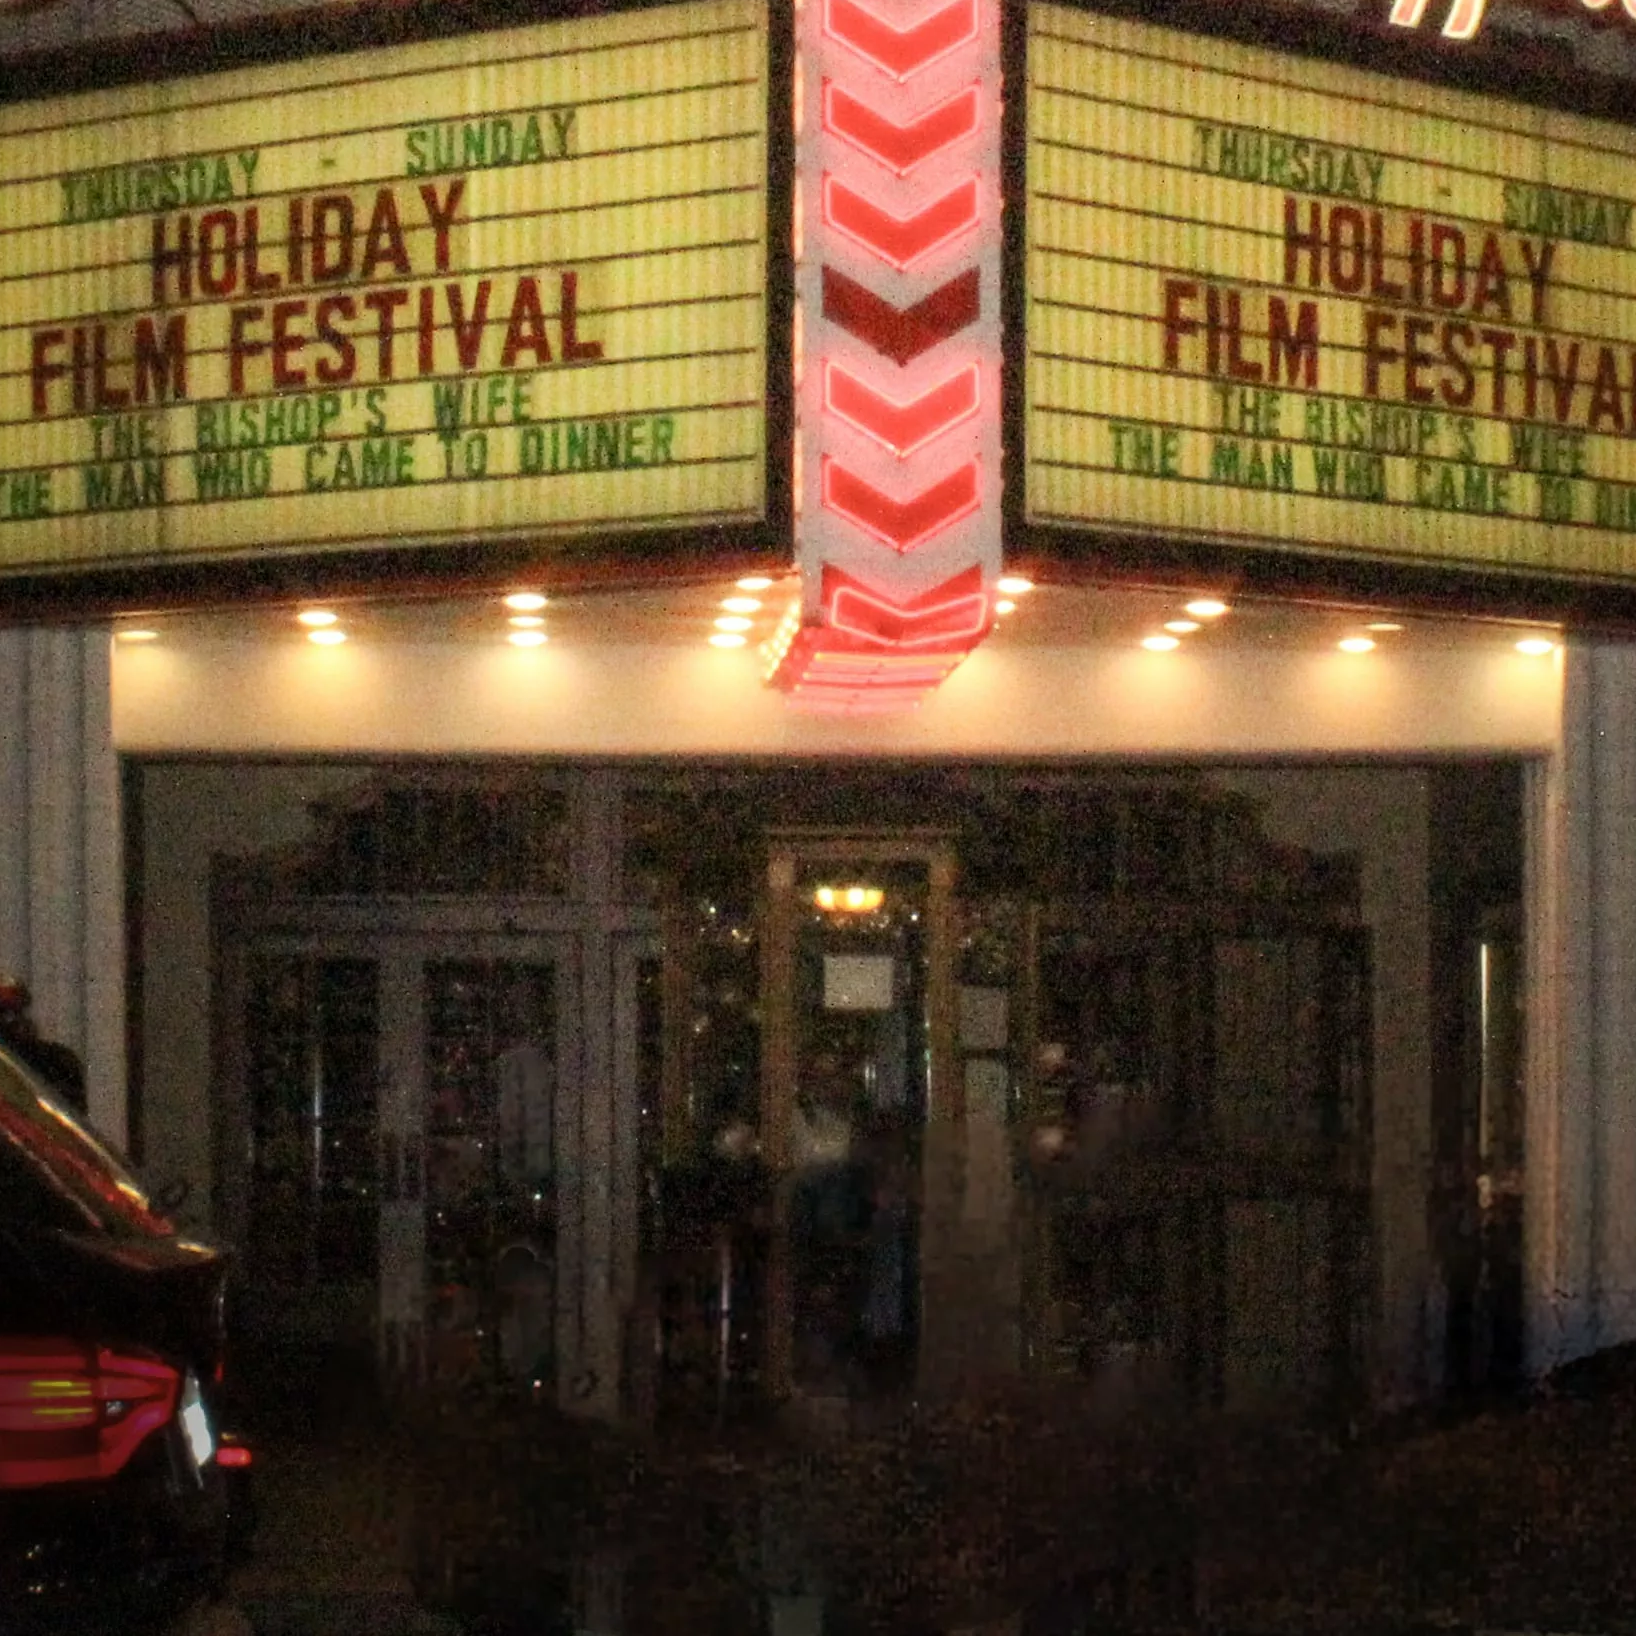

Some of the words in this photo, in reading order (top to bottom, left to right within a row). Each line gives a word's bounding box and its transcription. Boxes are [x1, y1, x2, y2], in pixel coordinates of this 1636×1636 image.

[61, 151, 261, 224] THURSDAY
[405, 110, 576, 176] SUNDAY
[1194, 121, 1386, 201] THURSDAY
[1503, 181, 1634, 244] SUNDAY
[151, 179, 467, 305] HOLIDAY
[1283, 196, 1556, 326] HOLIDAY
[30, 314, 186, 418] FILM
[228, 271, 606, 398] FESTIVAL
[1164, 278, 1320, 389] FILM
[85, 460, 165, 509] MAN
[195, 447, 273, 500] WHO
[303, 437, 415, 492] CAME
[437, 430, 489, 480] TO
[518, 417, 675, 474] DINNER
[91, 413, 157, 460] THE
[195, 386, 388, 451] BISHOP'S
[433, 374, 533, 441] WIFE
[1107, 419, 1179, 478] THE
[1210, 435, 1293, 490] MAN
[1312, 447, 1388, 500] WHO
[1415, 462, 1510, 512] CAME
[1212, 381, 1281, 438] THE
[1305, 398, 1476, 463] BISHOP'S
